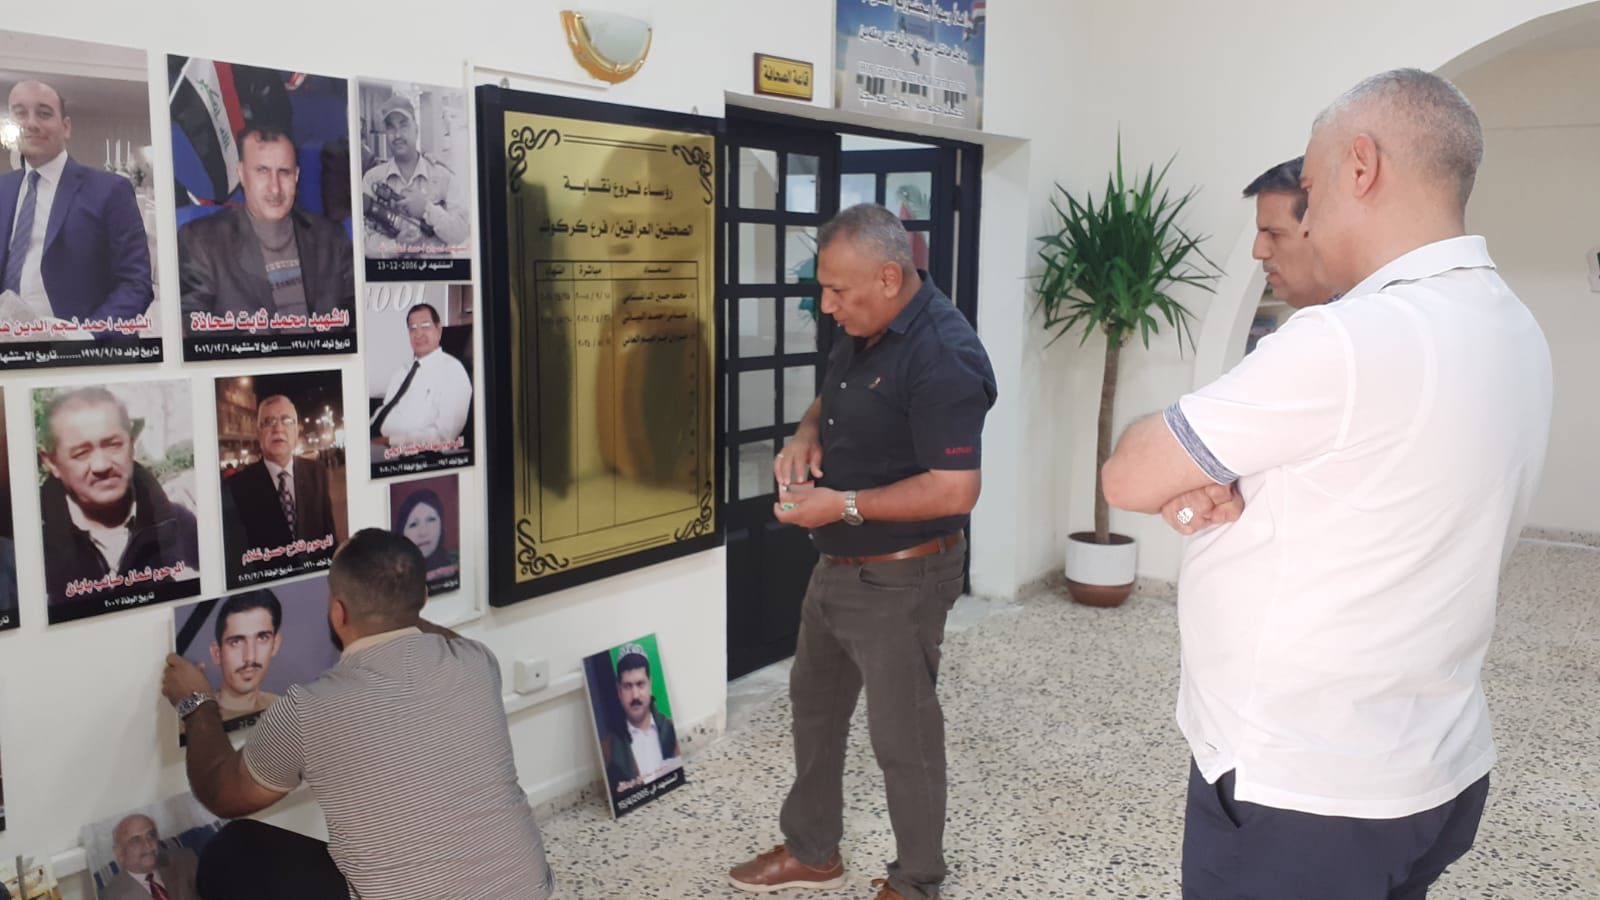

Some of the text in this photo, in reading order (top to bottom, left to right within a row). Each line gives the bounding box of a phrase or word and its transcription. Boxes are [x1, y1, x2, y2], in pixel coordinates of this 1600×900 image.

[50, 316, 79, 336] نجم
[82, 316, 113, 331] احمد
[115, 313, 152, 335] الشهيد
[236, 307, 269, 333] ثابت
[270, 312, 307, 329] محمد
[308, 307, 349, 332] الشهيد
[14, 320, 47, 336] الدين
[322, 339, 334, 349] تولد
[335, 338, 350, 350] تاريخ
[0, 351, 35, 364] الاستشها
[124, 347, 140, 357] تولد
[141, 346, 160, 358] تاريخ
[307, 533, 334, 553] المرحوم
[263, 546, 286, 561] حسن
[124, 566, 152, 586] شمال
[153, 560, 185, 581] المرحوم
[121, 595, 138, 606] الوفاة
[139, 592, 155, 603] تاريخ
